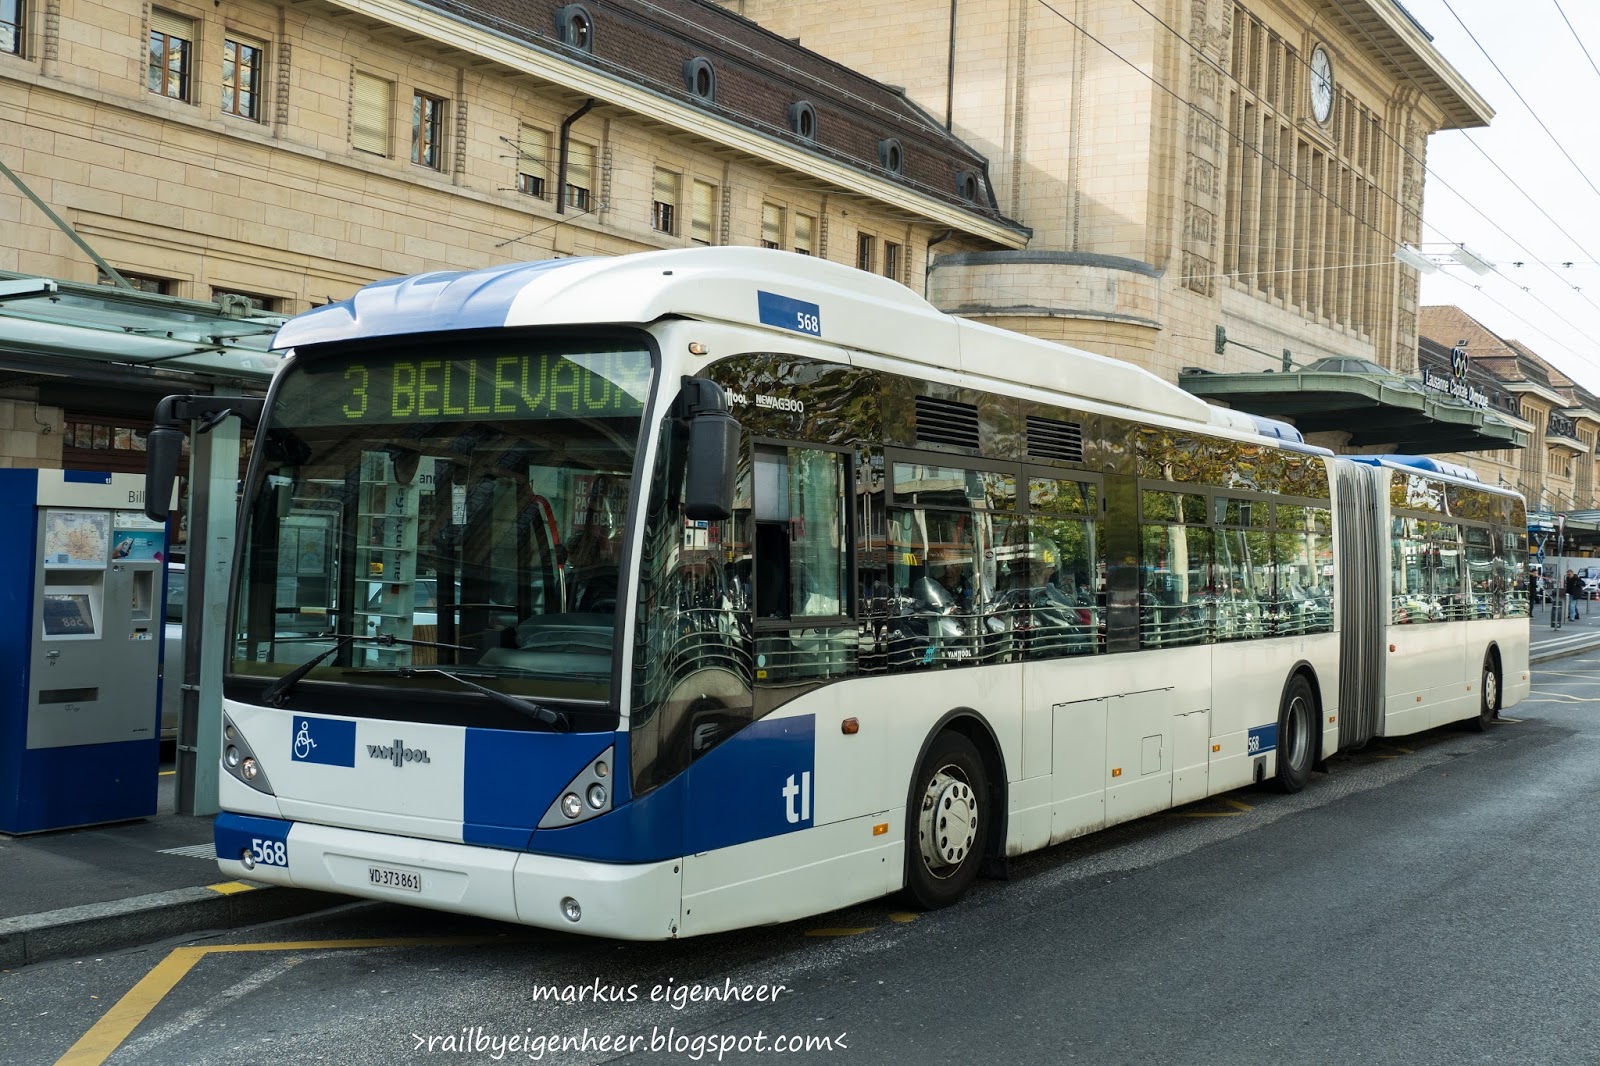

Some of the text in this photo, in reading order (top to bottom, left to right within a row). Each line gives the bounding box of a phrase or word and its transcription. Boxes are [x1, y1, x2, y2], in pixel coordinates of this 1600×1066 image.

[797, 312, 819, 333] 568
[342, 350, 645, 418] 3 BELLEVAUX
[1426, 369, 1449, 393] Lausanne
[1450, 379, 1468, 398] Capitale
[128, 490, 145, 503] Bill
[1248, 735, 1260, 752] 568
[782, 771, 811, 823] tl
[252, 839, 287, 866] 568
